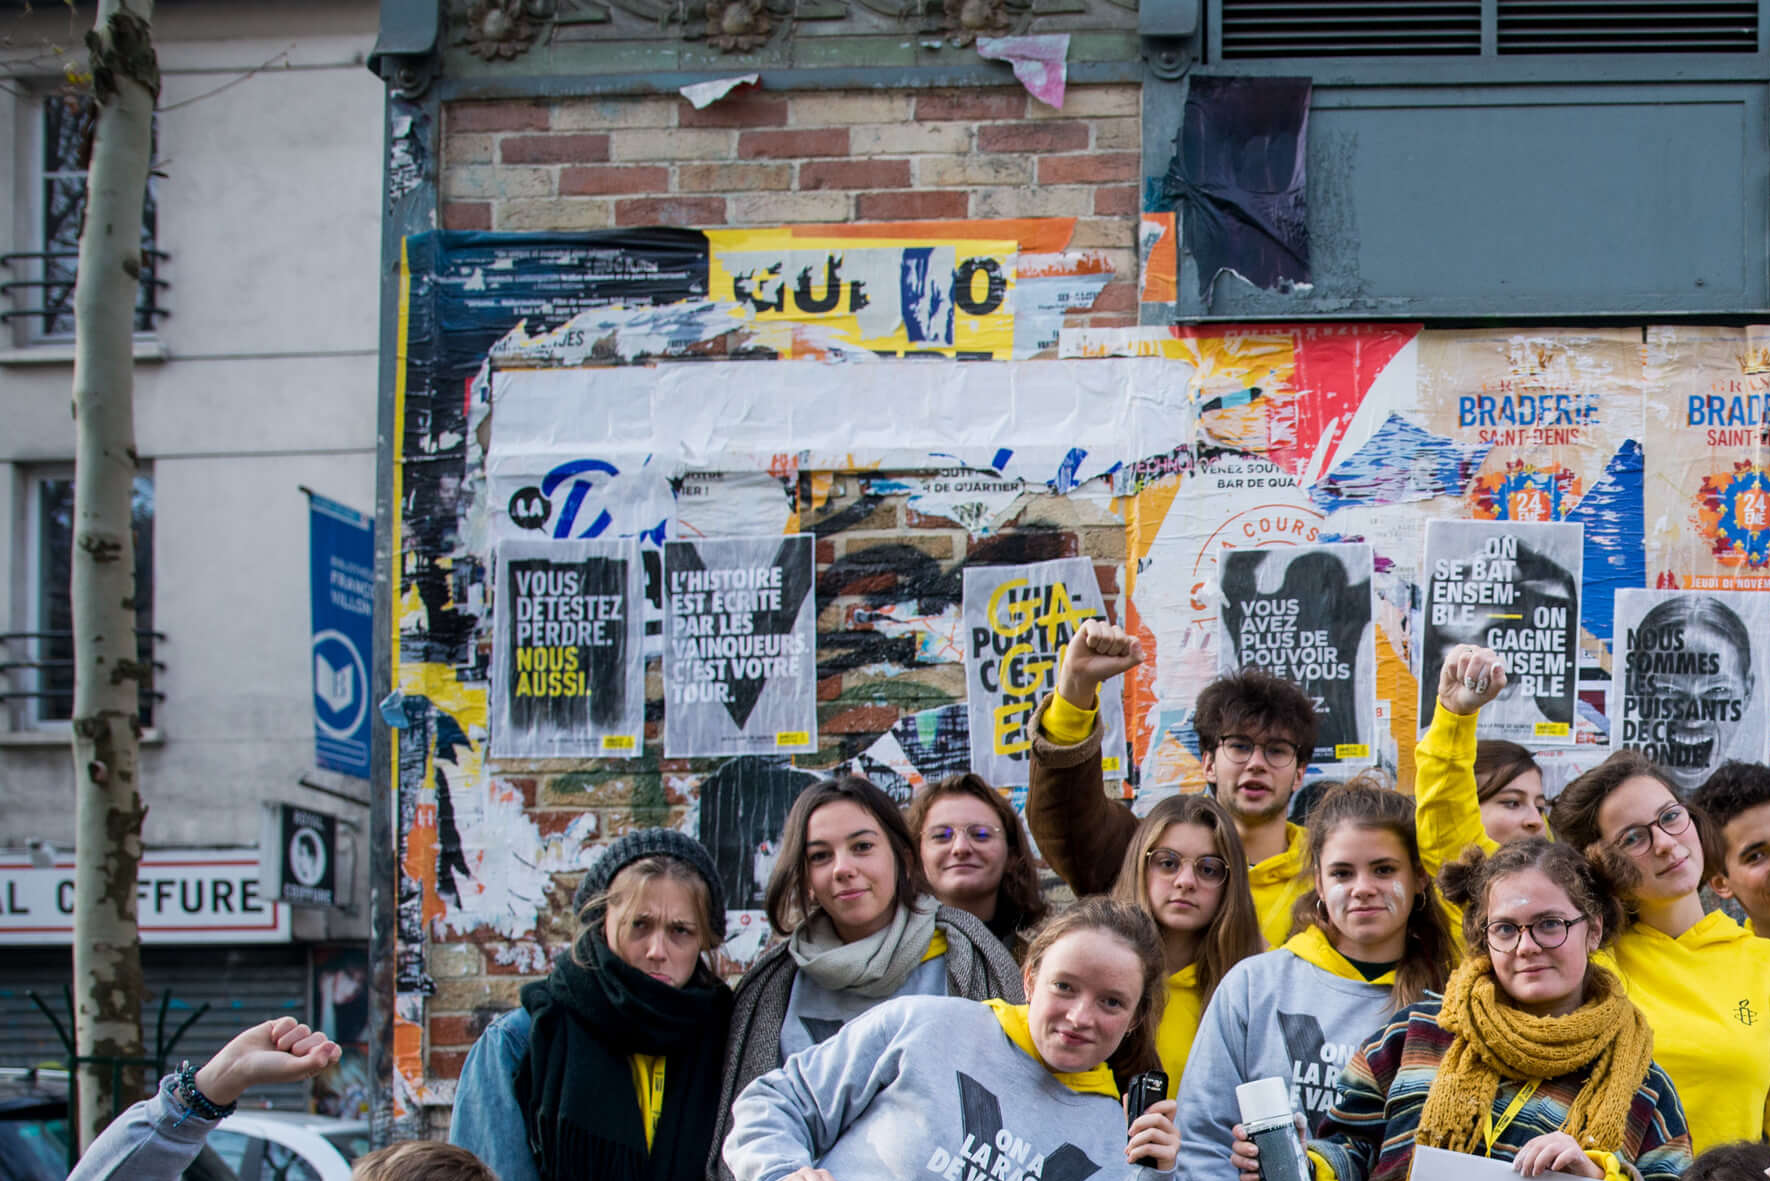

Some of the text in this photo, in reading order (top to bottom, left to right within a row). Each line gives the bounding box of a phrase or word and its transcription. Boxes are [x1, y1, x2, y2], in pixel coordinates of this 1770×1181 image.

[1459, 393, 1600, 428] BRADERIE
[1201, 463, 1281, 474] VENEZ SOUT
[933, 481, 1019, 494] DE QUARTIER
[1217, 478, 1297, 489] BAR DE QUA
[1744, 493, 1767, 513] 24
[1242, 517, 1321, 543] COURS
[1485, 536, 1517, 560] ON
[671, 567, 782, 593] L'HISTOIRE
[1434, 559, 1517, 581] SE BAT
[515, 570, 580, 596] VOUS
[1433, 581, 1521, 605] ENSEM-
[672, 592, 707, 616] EST
[1240, 599, 1300, 617] VOUS
[1431, 604, 1476, 627] BLE
[673, 613, 754, 637] PAR LES
[1240, 615, 1298, 633] AVEZ
[1533, 606, 1567, 629] ON
[516, 621, 613, 646] PERDRE.
[1240, 631, 1329, 650] PLUS DE
[1487, 627, 1566, 652] GAGNE
[1627, 628, 1685, 651] NOUS
[673, 633, 810, 659] VAINQUEURS.
[1240, 647, 1338, 667] POUVOIR
[516, 647, 579, 672] NOUS
[730, 656, 801, 681] VOTRE
[1625, 652, 1720, 675] SOMMES
[516, 671, 592, 697] AUSSI.
[1290, 663, 1351, 681] VOUS
[673, 681, 736, 704] TOUR.
[1520, 674, 1565, 697] BLE
[1623, 698, 1742, 722] PUISSANTS
[1292, 1061, 1321, 1085] LA
[960, 1133, 990, 1173] LA
[994, 1129, 1046, 1177] ON A
